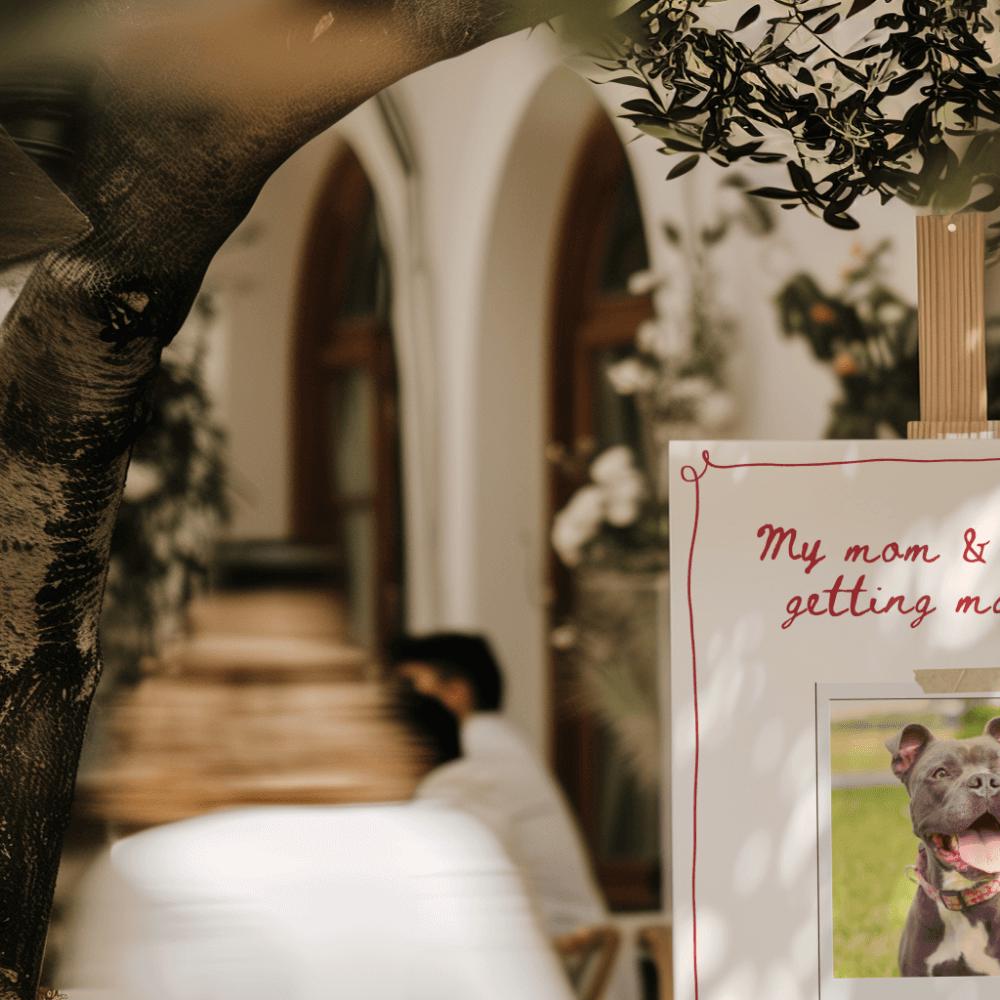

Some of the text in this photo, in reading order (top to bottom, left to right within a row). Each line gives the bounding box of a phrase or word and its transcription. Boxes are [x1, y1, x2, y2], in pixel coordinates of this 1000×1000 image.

[757, 524, 826, 574] My
[844, 543, 940, 564] mom
[963, 528, 990, 564] &
[781, 575, 937, 629] getting
